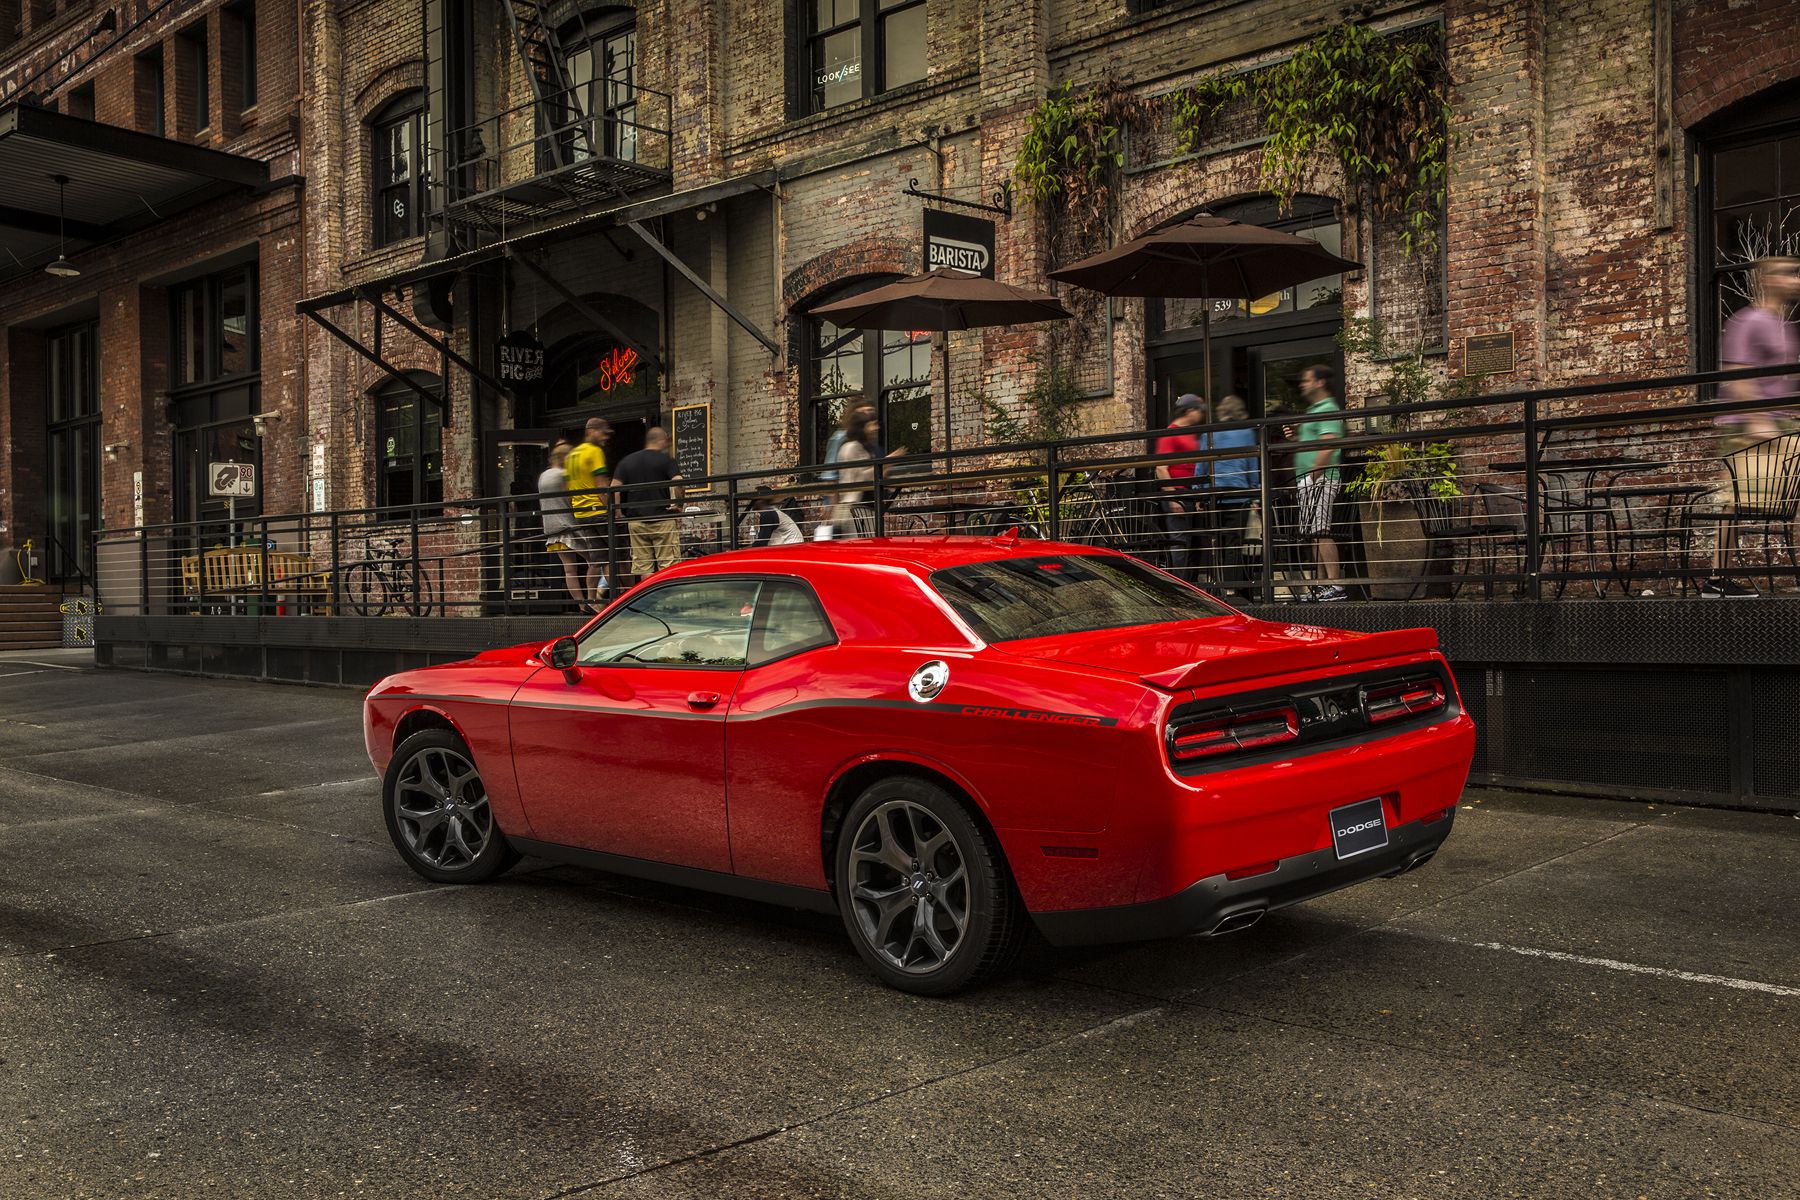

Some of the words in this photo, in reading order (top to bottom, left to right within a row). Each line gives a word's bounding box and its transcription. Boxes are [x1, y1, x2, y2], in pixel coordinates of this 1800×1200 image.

[929, 243, 982, 271] BARISTA
[1214, 299, 1232, 312] 539
[499, 345, 544, 366] RIVER
[500, 362, 525, 381] PIG
[240, 467, 254, 479] 90
[960, 706, 1101, 727] CHALLENGER
[1337, 818, 1382, 837] DODGE
